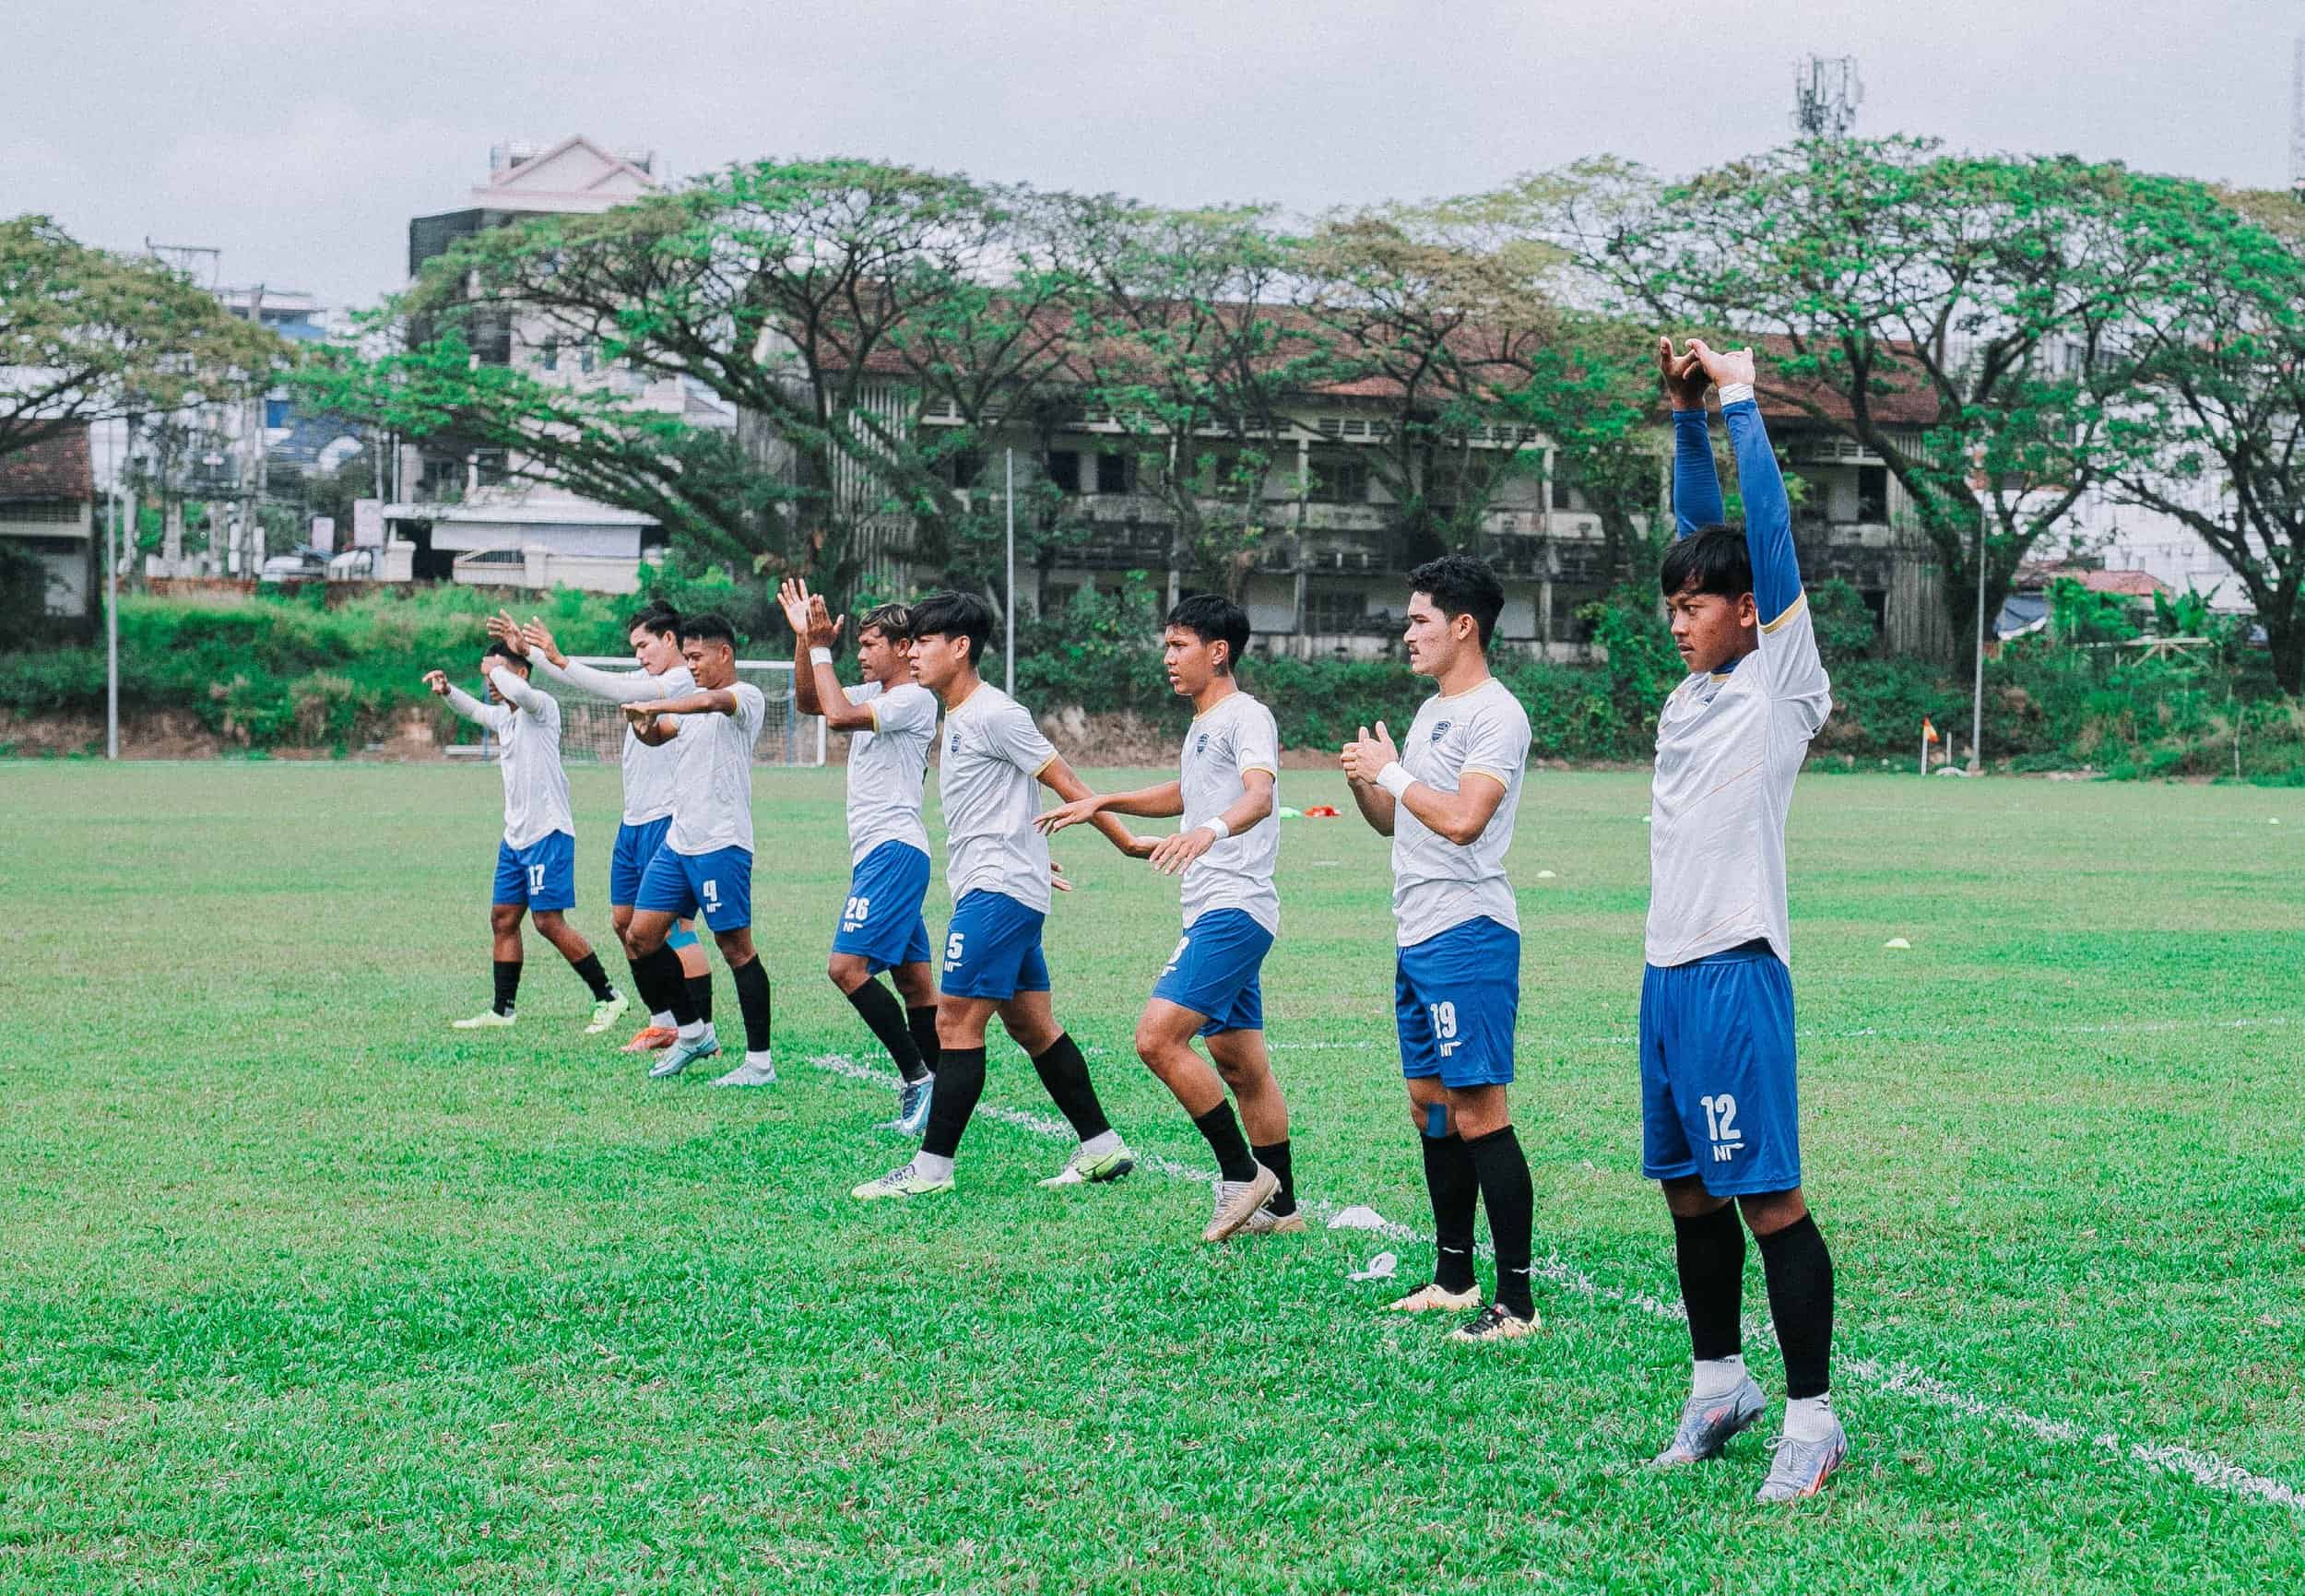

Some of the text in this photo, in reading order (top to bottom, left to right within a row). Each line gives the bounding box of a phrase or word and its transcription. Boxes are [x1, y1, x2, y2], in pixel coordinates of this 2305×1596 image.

[528, 864, 545, 886] 17
[703, 880, 717, 902] 9
[845, 896, 869, 920] 26
[947, 933, 964, 959] 5
[1430, 1001, 1457, 1039] 19
[1700, 1094, 1741, 1141] 12
